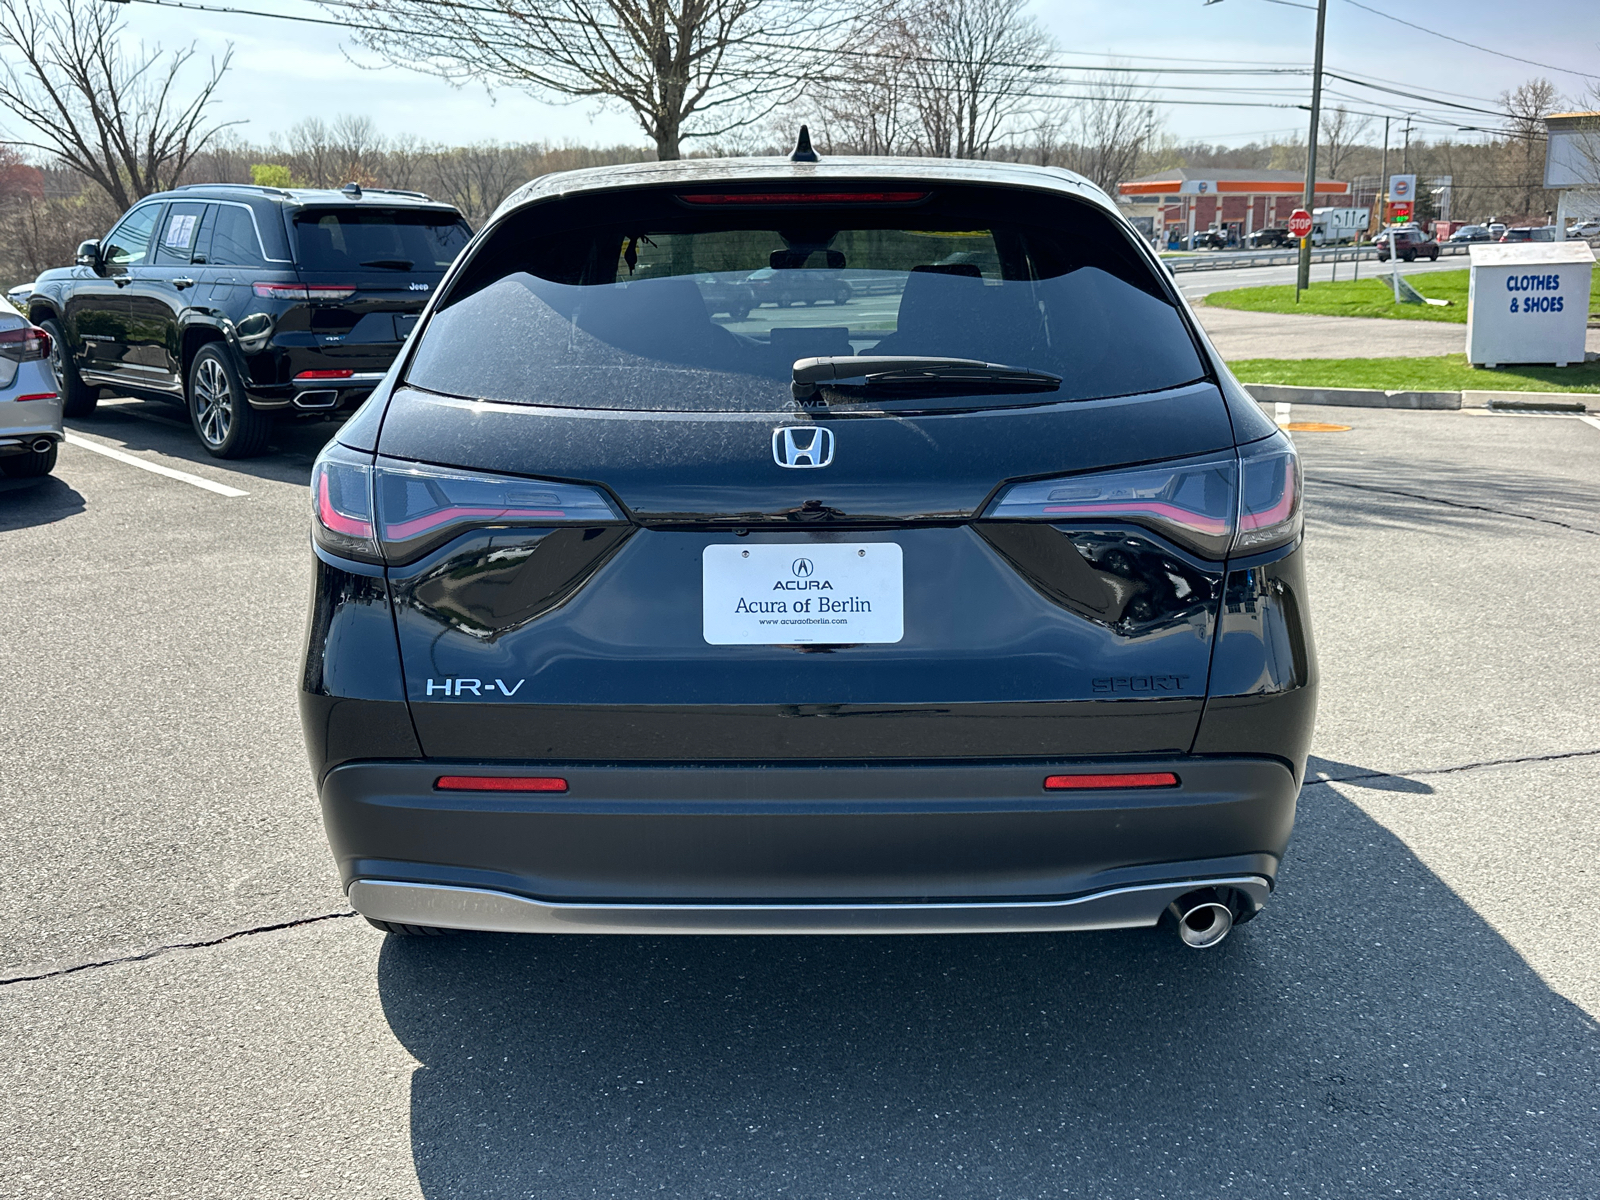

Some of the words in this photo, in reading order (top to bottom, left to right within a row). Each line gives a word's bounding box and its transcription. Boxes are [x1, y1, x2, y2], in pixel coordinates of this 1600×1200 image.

[1290, 218, 1311, 230] STOP
[409, 282, 429, 291] Jeep
[1506, 274, 1560, 291] CLOTHES
[1510, 297, 1519, 313] &
[1523, 296, 1564, 313] SHOES
[772, 580, 834, 591] ACURA
[735, 597, 788, 613] Acura
[793, 598, 811, 613] of
[818, 596, 872, 613] Berlin
[426, 678, 526, 697] HR-V
[1091, 675, 1190, 693] SPORT
